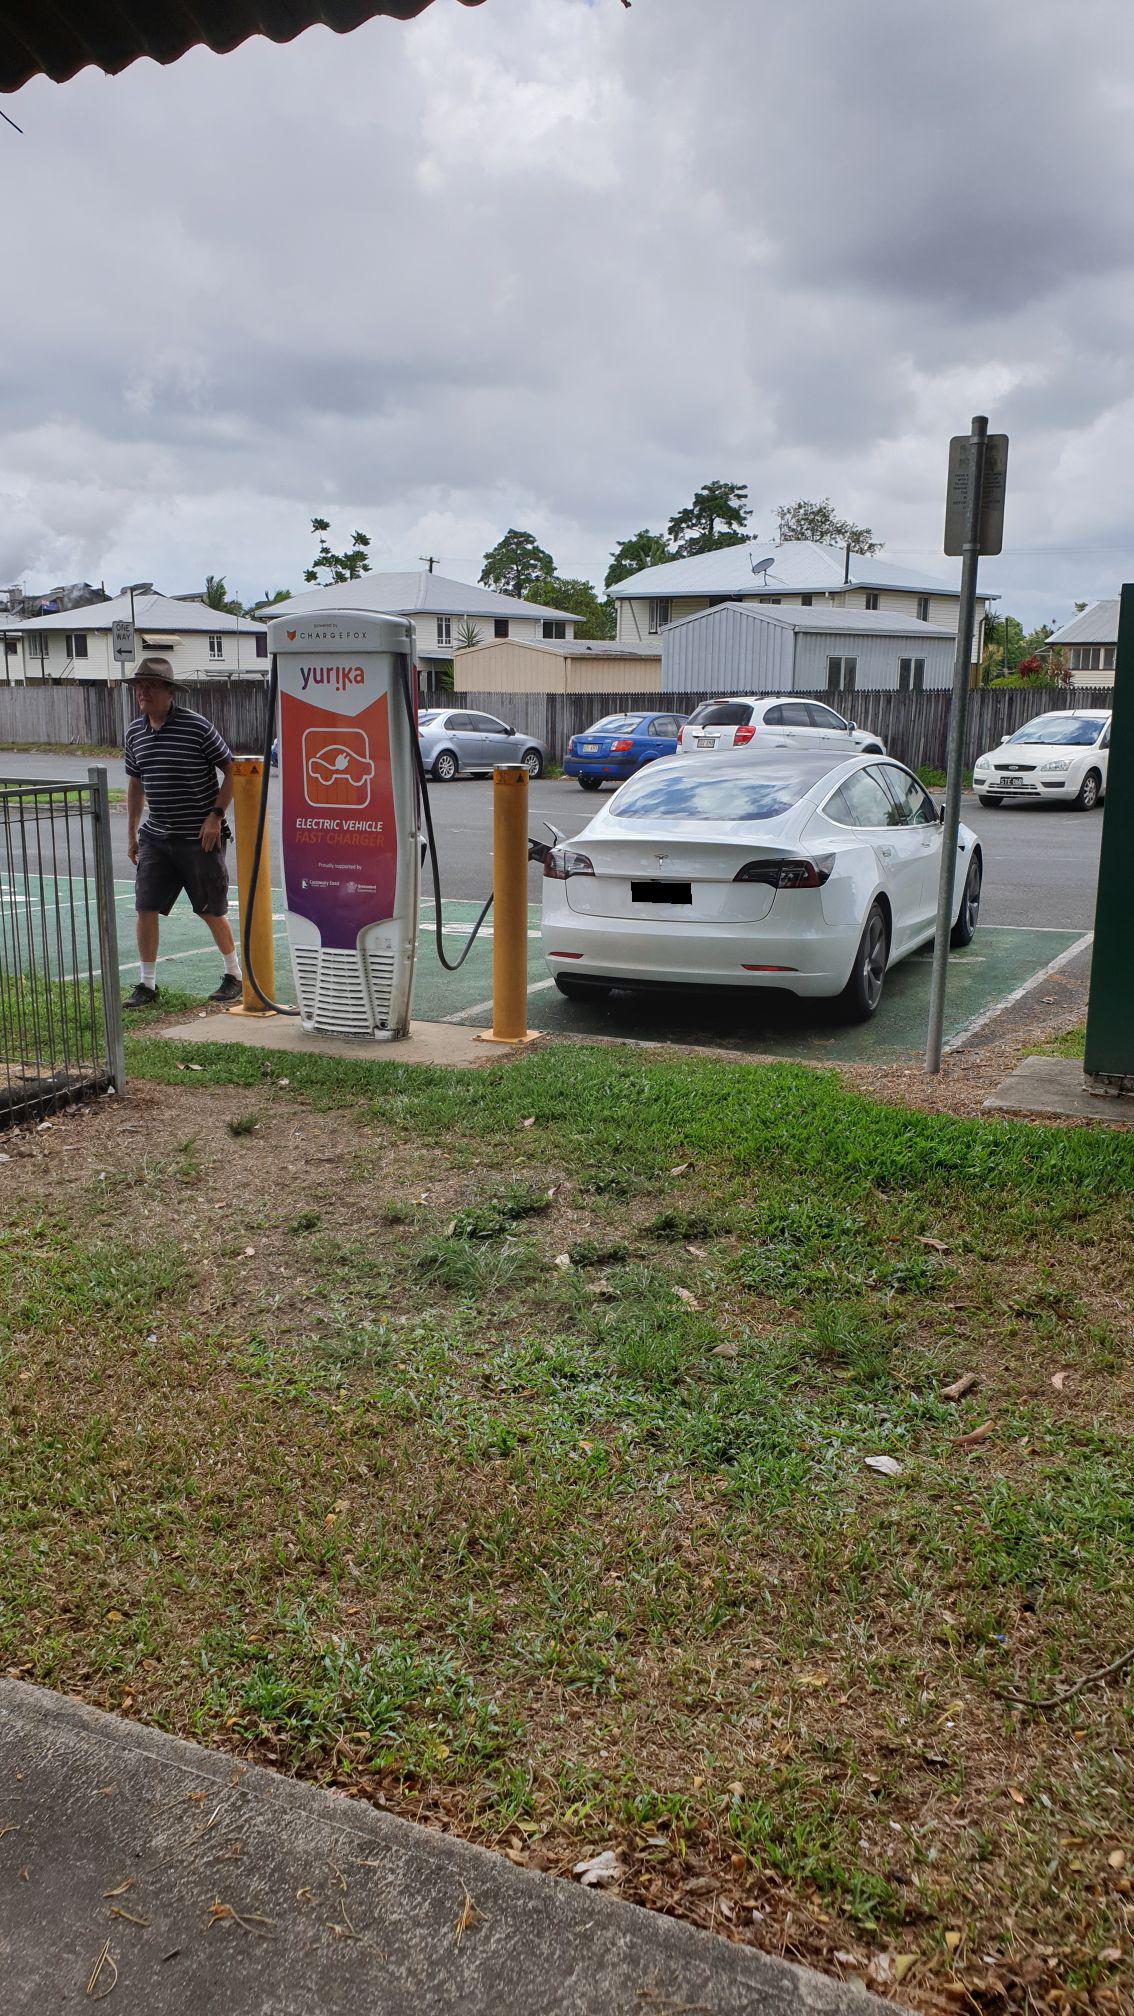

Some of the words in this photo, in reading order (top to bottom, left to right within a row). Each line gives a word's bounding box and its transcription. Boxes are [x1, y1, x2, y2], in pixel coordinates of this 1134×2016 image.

[300, 666, 365, 691] yurika
[296, 818, 340, 830] ELECTRIC
[343, 820, 384, 832] VEHICLE
[296, 831, 324, 844] FAST
[326, 833, 385, 847] CHARGER
